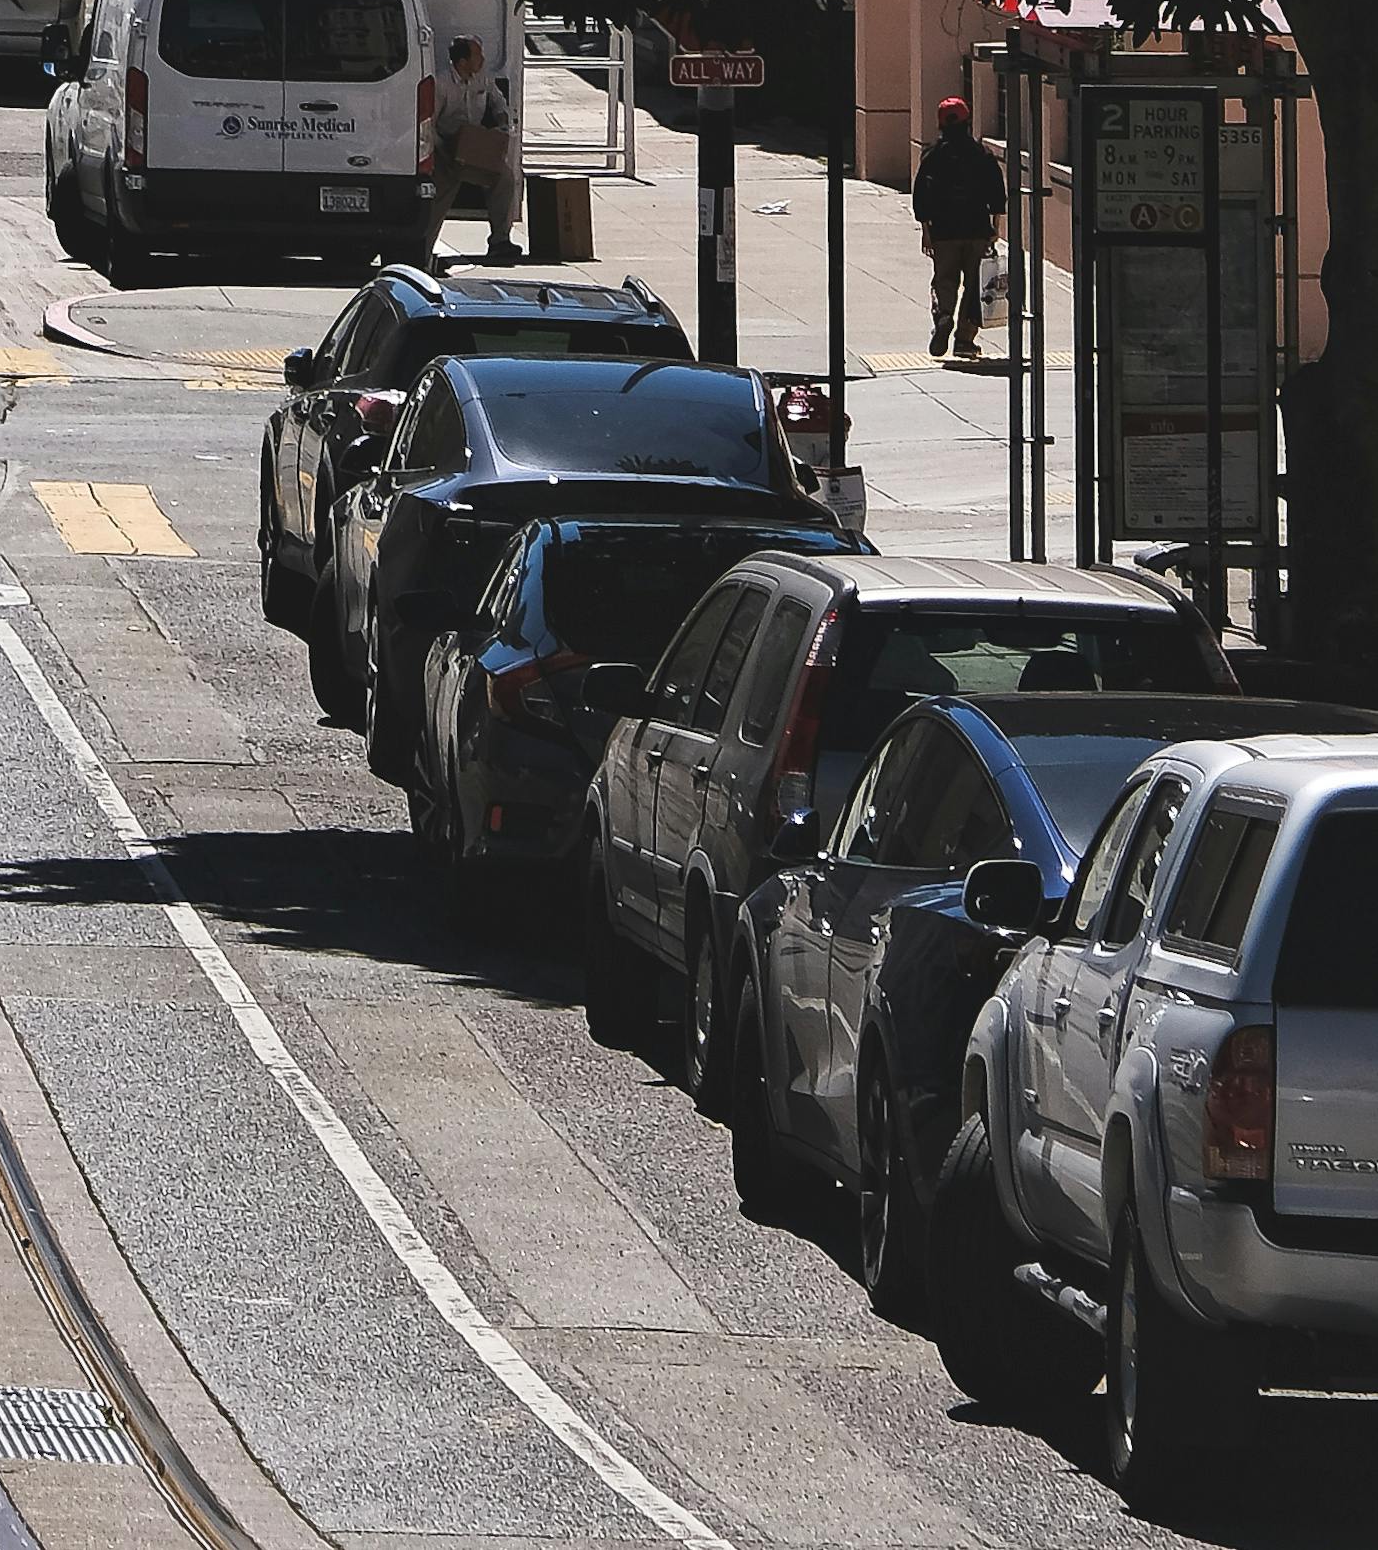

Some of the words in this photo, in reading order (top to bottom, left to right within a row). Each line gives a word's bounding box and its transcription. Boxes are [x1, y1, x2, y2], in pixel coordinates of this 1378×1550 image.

[678, 63, 711, 79] ALL
[722, 63, 756, 79] WAY
[1101, 103, 1123, 131] 2
[1145, 108, 1188, 121] HOUR
[247, 116, 298, 132] Sunrise
[301, 117, 356, 133] Medical
[1133, 125, 1201, 139] PARKING
[1220, 130, 1261, 144] 5356
[1104, 145, 1116, 165] 8
[1164, 145, 1176, 165] 9
[1102, 172, 1136, 185] MON
[1171, 172, 1198, 186] SAT
[1136, 205, 1153, 227] A
[1179, 206, 1194, 228] C
[1289, 1157, 1378, 1174] TACO
